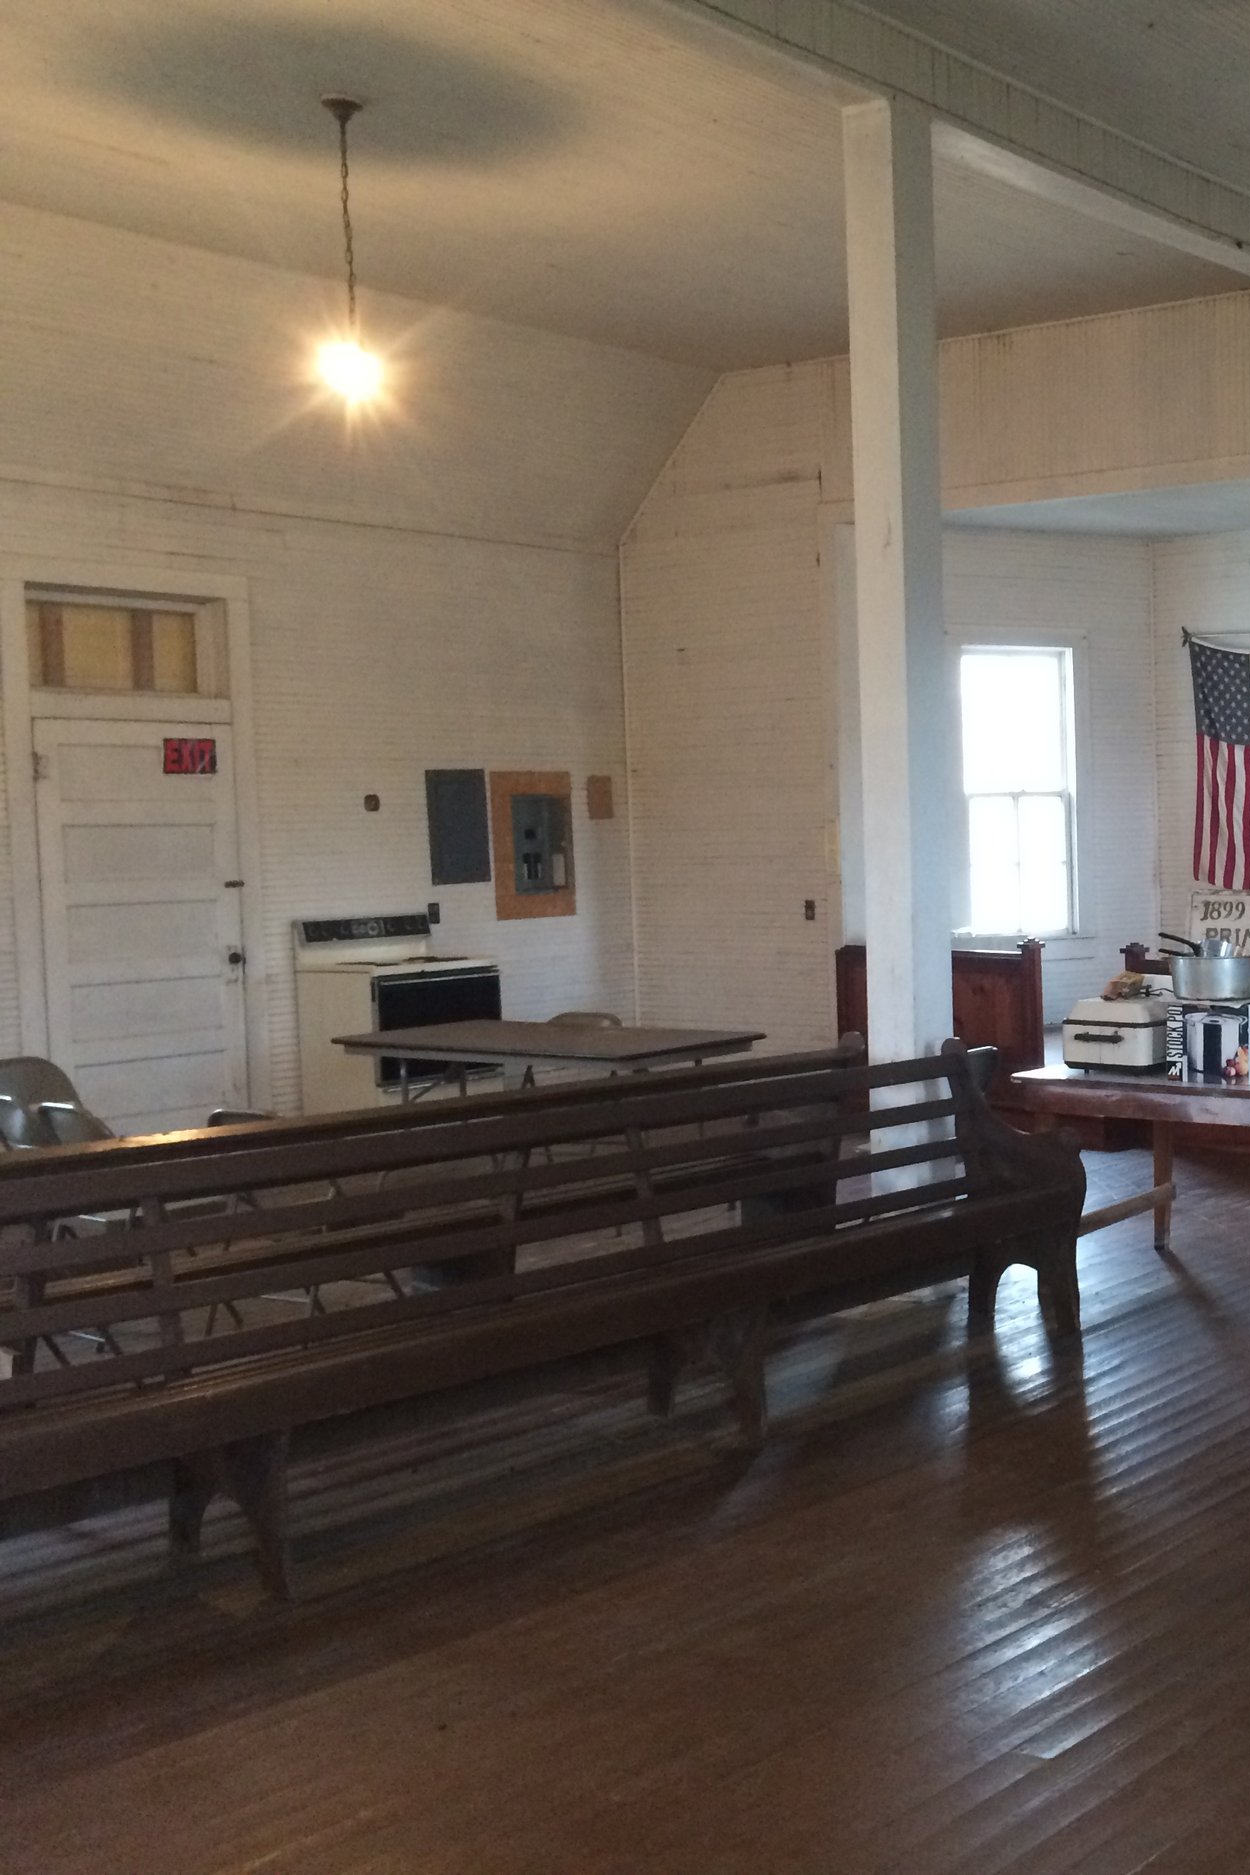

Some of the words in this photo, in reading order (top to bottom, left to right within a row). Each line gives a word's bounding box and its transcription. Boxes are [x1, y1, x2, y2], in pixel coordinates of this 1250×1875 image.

[165, 740, 215, 774] EXIT
[1200, 901, 1246, 921] 1899
[1166, 1026, 1183, 1058] STOCK
